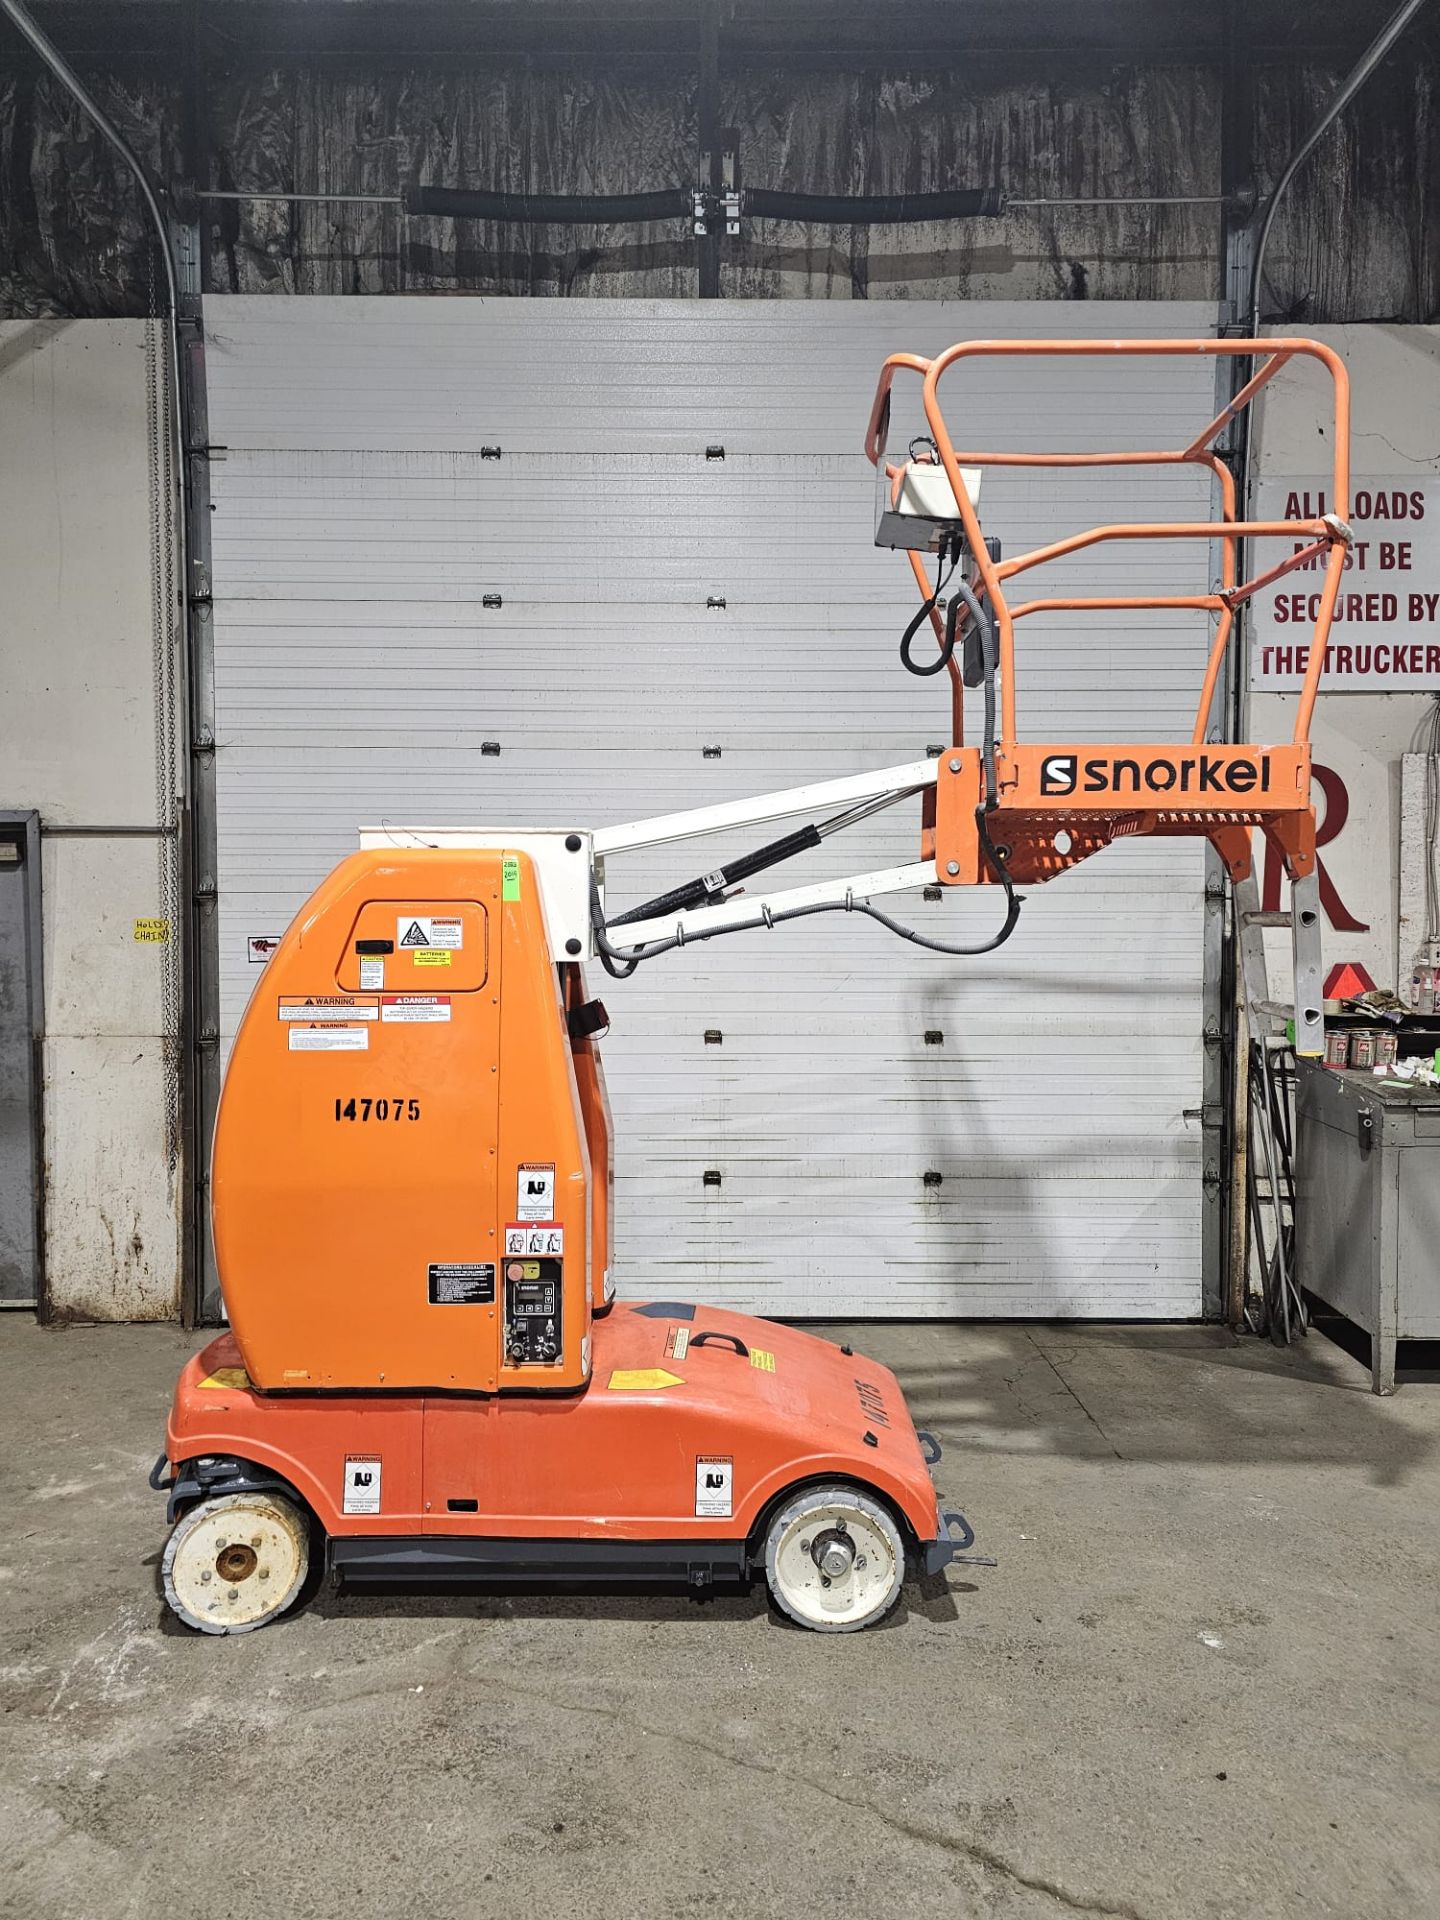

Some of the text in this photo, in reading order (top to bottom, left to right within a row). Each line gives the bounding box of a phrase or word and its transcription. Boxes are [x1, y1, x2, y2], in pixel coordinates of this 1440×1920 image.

[1284, 491, 1425, 520] ALL OADS
[1379, 542, 1412, 570] BE
[1408, 593, 1440, 622] BY
[1261, 645, 1440, 674] THE TRUCKER
[1084, 755, 1270, 793] snorkel
[134, 931, 166, 941] CHAIN
[315, 998, 355, 1006] WARNING
[335, 1098, 420, 1121] 147075
